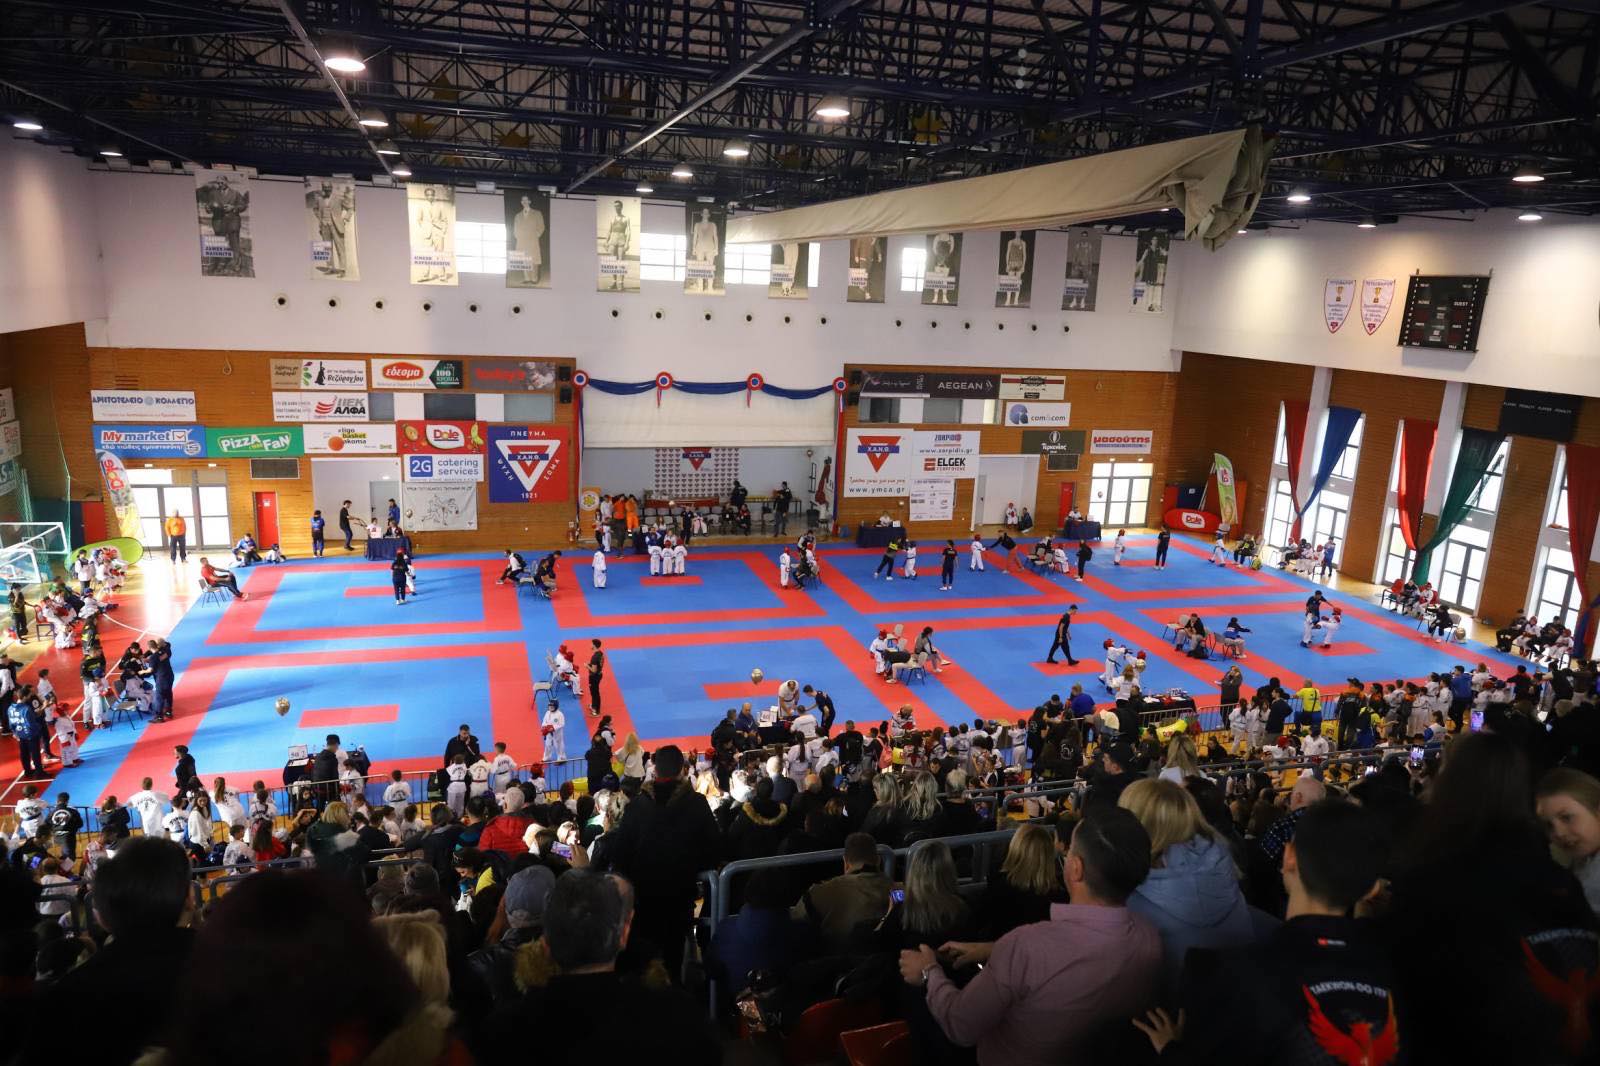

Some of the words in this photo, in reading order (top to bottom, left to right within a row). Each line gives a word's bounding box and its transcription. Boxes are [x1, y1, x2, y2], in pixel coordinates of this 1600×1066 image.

[436, 369, 452, 377] 100
[938, 382, 983, 390] AEGEAN
[334, 406, 366, 415] ΑΛΦΑ
[103, 431, 122, 442] My
[125, 430, 170, 441] market
[433, 429, 460, 439] Dole
[437, 458, 479, 469] catering
[937, 458, 966, 466] ELGEK
[411, 460, 432, 473] 2G
[437, 468, 480, 476] services
[849, 486, 905, 494] www.ymca.gr
